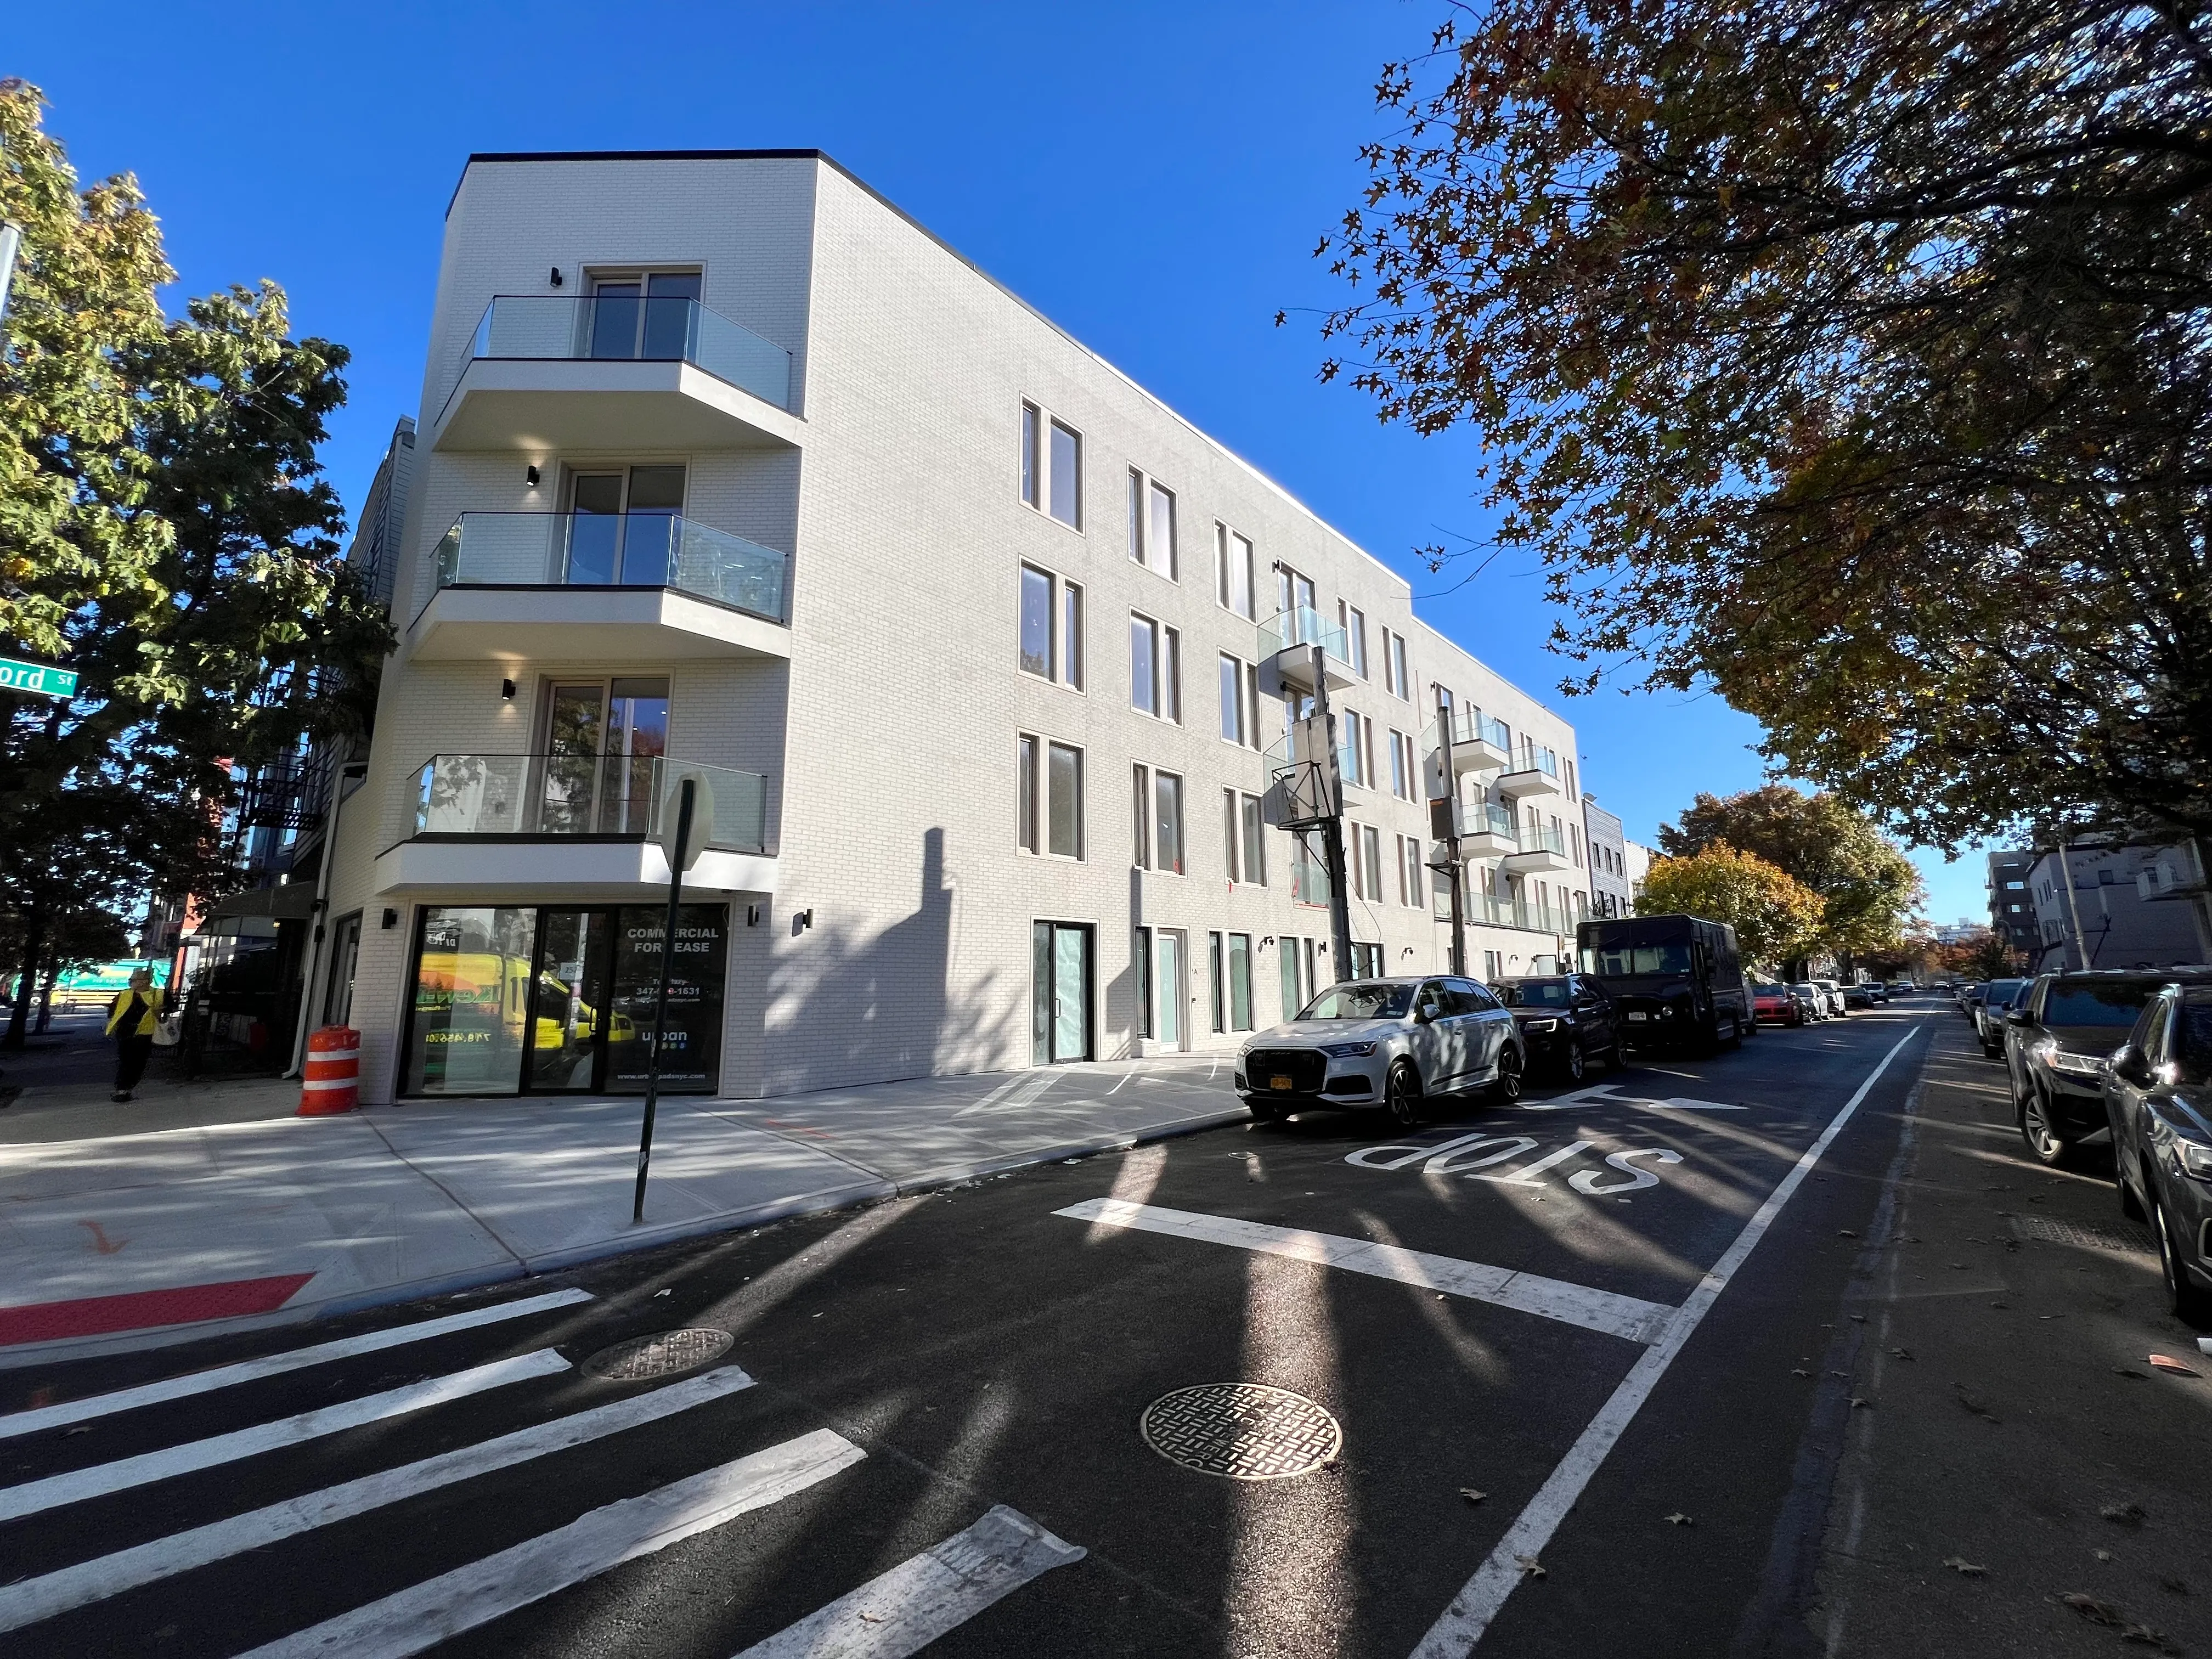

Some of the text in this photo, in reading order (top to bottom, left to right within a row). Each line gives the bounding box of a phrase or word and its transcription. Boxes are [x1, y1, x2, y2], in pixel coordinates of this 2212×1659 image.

[0, 667, 74, 690] ord St
[634, 942, 710, 953] FOR EASE
[642, 1032, 687, 1041] uan
[1344, 1133, 1685, 1195] STOP
